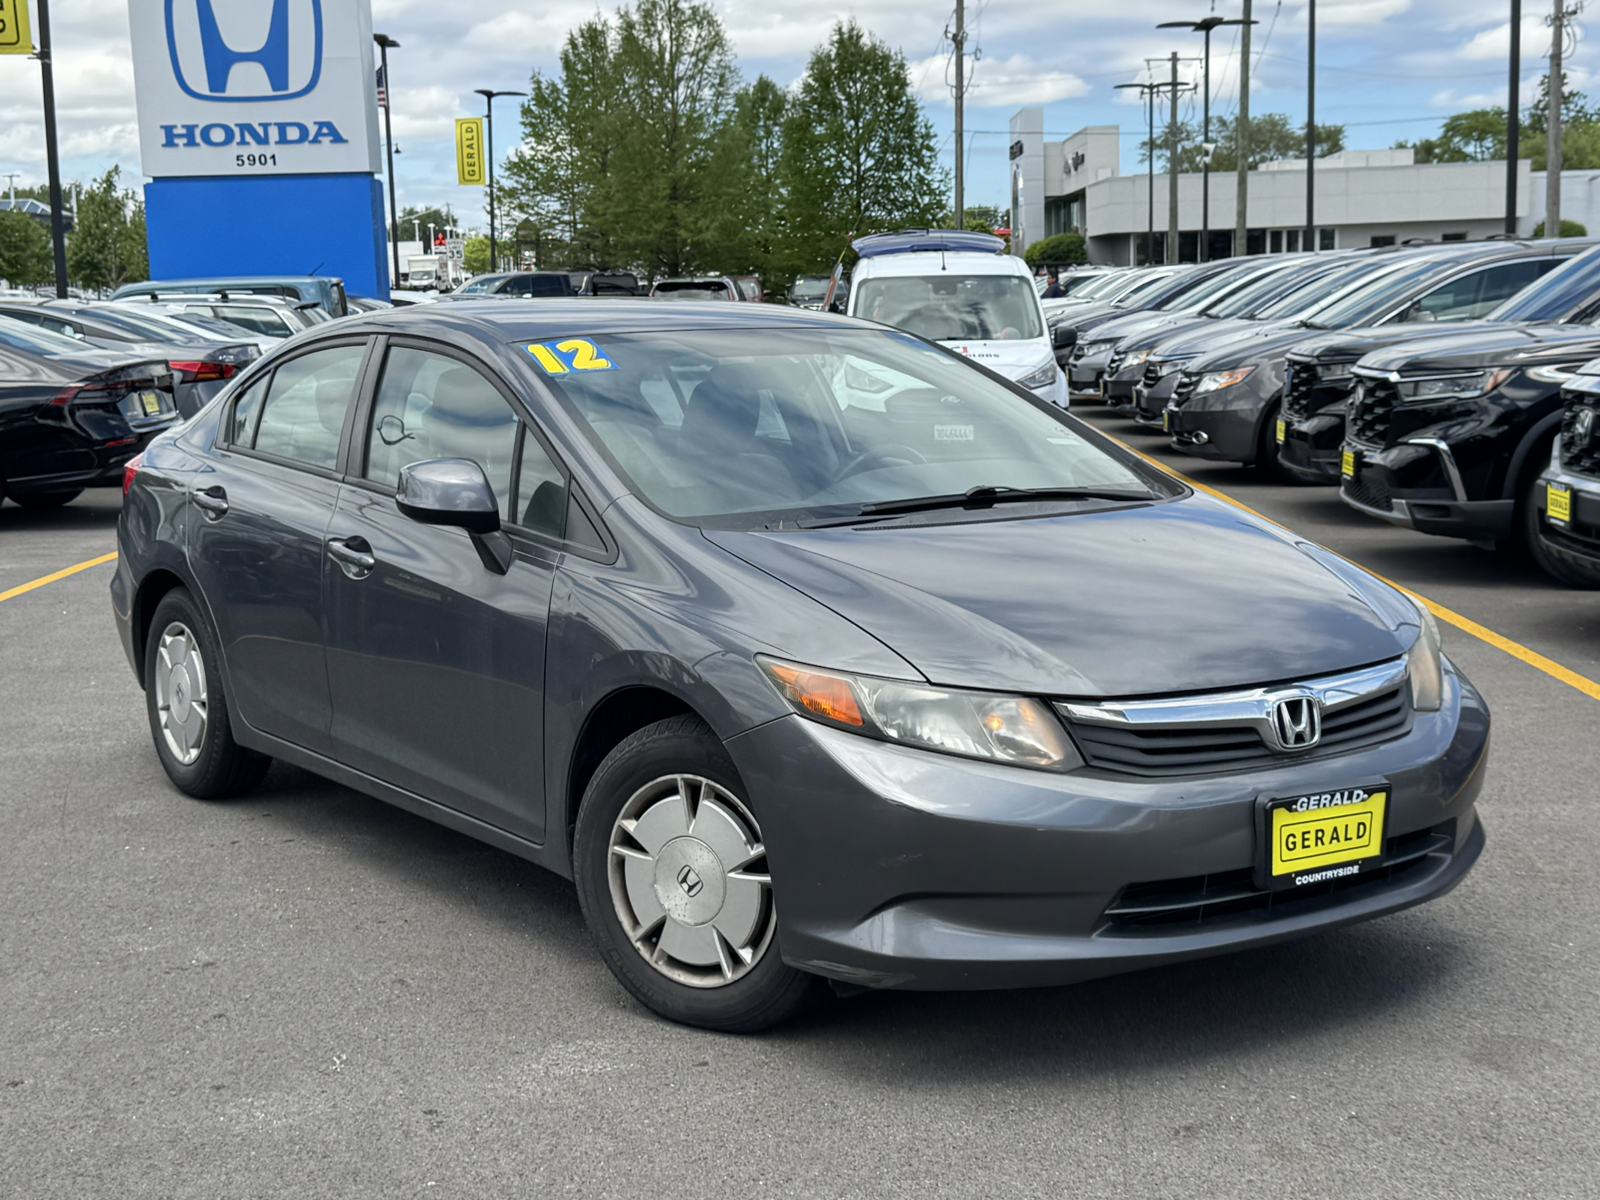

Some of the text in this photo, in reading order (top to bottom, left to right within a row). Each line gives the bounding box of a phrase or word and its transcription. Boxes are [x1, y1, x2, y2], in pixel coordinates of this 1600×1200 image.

[159, 121, 349, 147] HONDA
[236, 154, 277, 167] 5901
[465, 126, 476, 177] GERALD
[449, 250, 463, 259] 35
[527, 339, 612, 374] 12
[1296, 789, 1364, 812] GERALD
[1285, 822, 1367, 852] GERALD
[1295, 864, 1360, 885] COUNTRYSIDE
